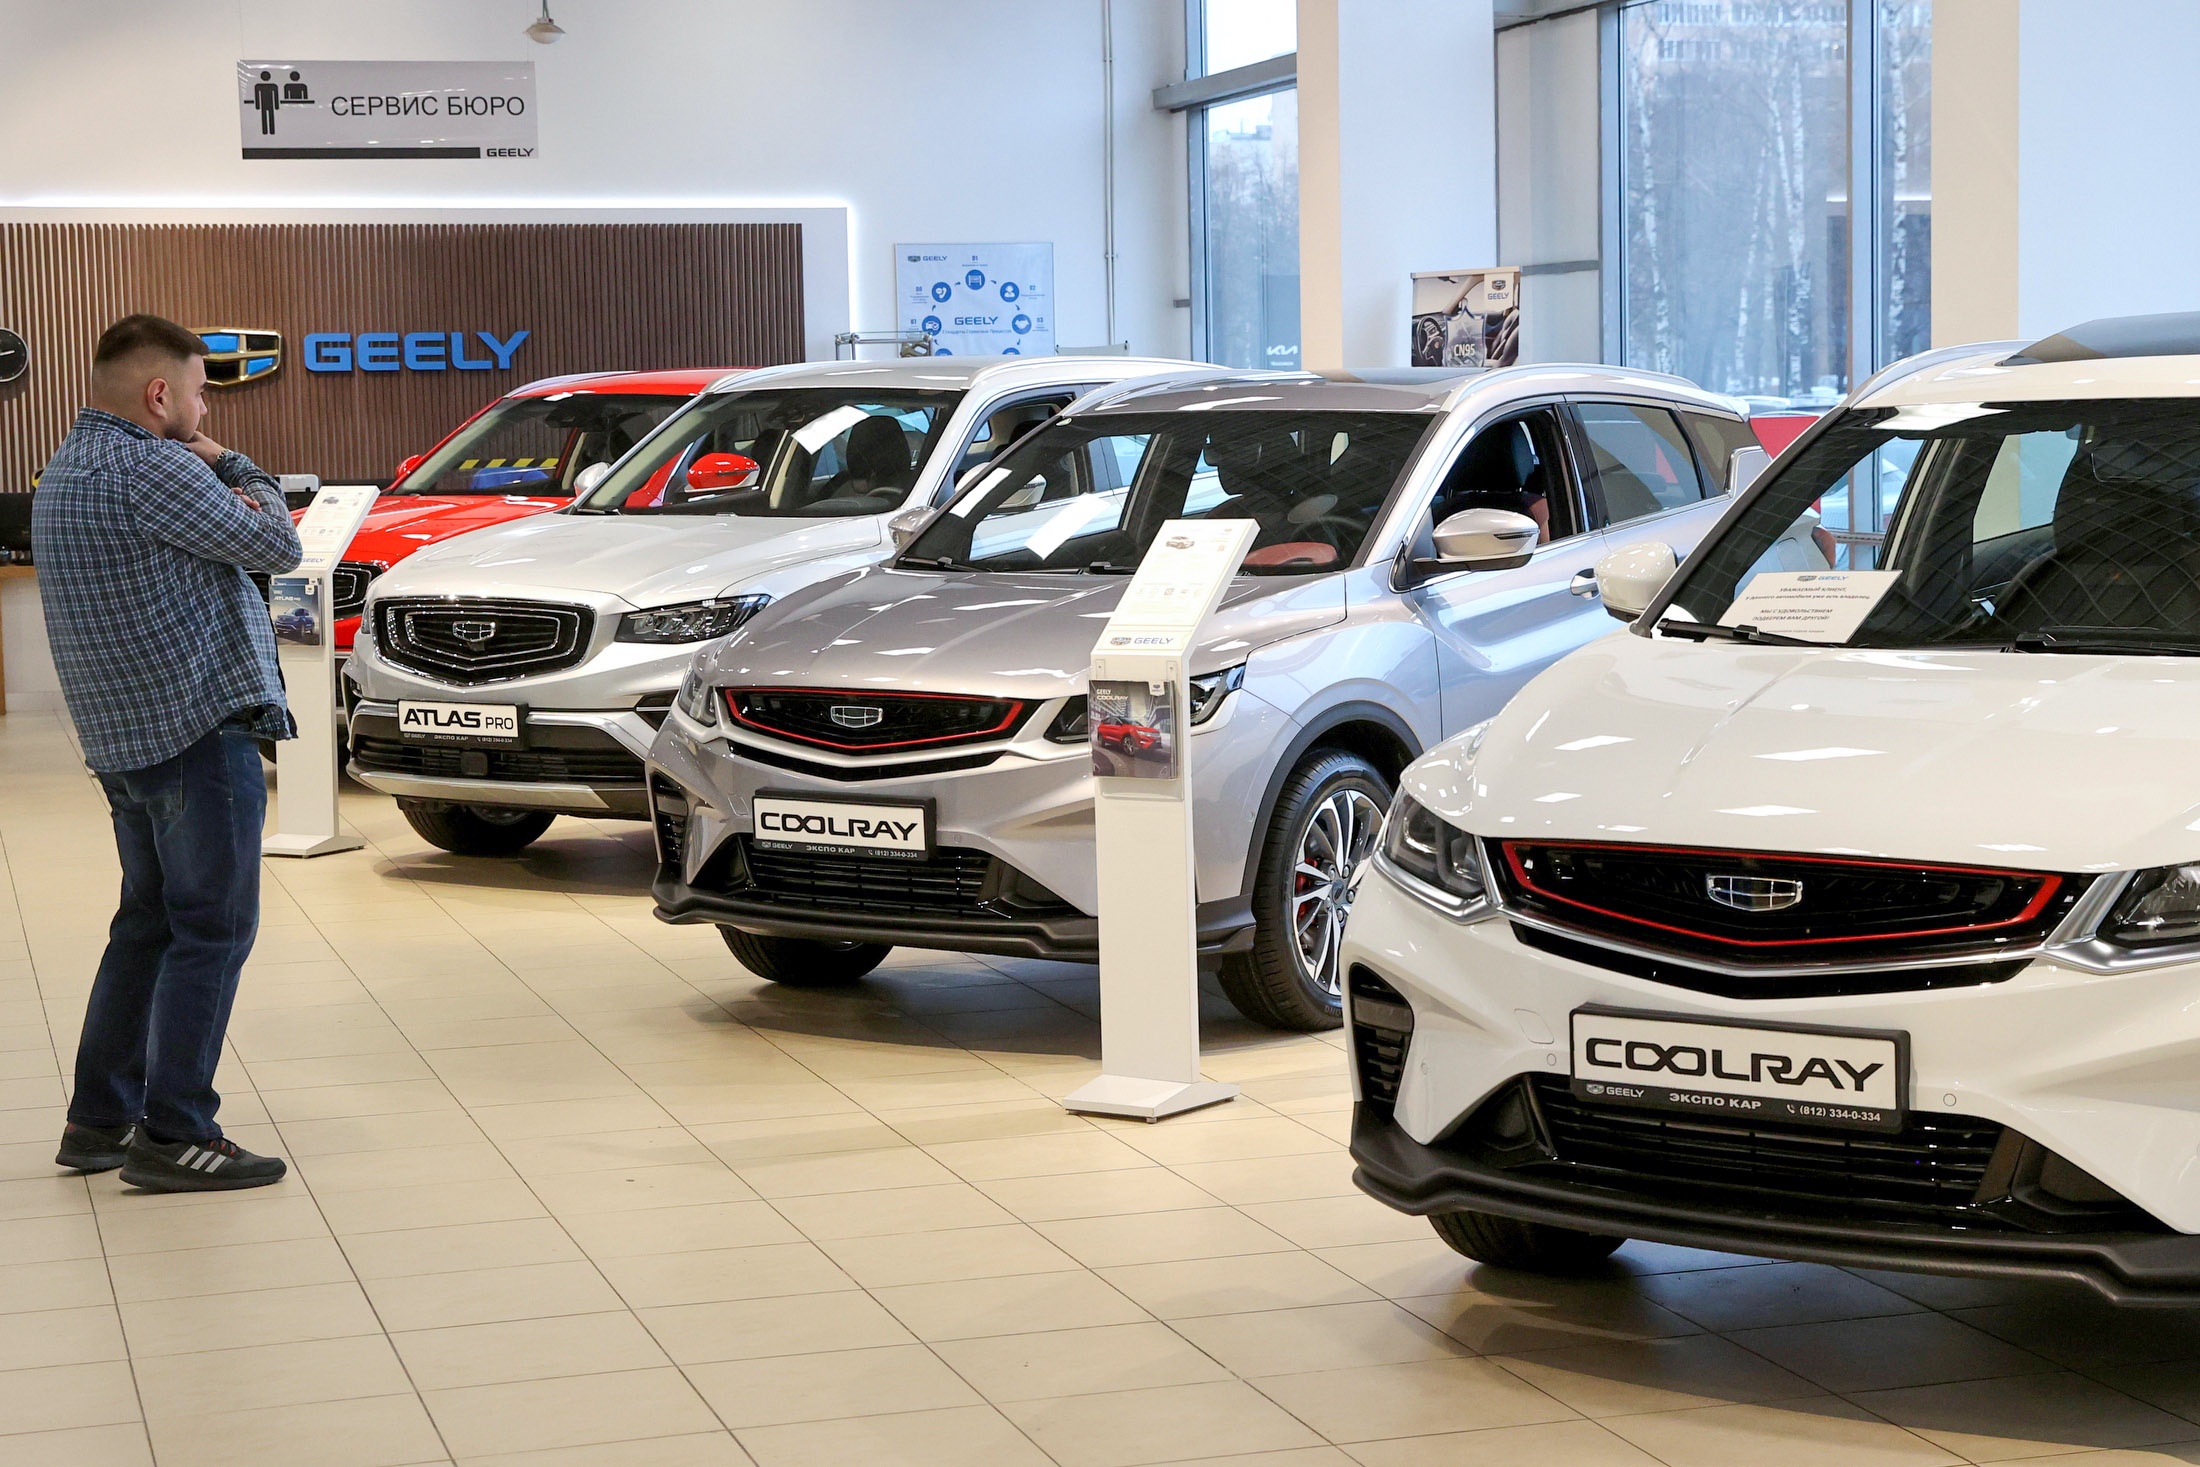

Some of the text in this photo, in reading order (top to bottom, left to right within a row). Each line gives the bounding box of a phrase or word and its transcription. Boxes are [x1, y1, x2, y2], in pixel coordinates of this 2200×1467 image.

[331, 96, 525, 116] СЕРВИС БЮРО
[486, 148, 534, 158] GEELY
[1487, 292, 1510, 300] GEELY
[954, 316, 999, 326] GEELY
[303, 331, 531, 372] GEELY
[1453, 343, 1475, 356] CN95
[404, 708, 514, 730] ATLAS PRO
[761, 811, 918, 842] COOLRAY
[806, 845, 836, 853] ЭКСПО
[874, 850, 890, 858] (812)
[1586, 1037, 1885, 1093] COOLRAY
[1606, 1086, 1645, 1098] GEELY
[1669, 1092, 1762, 1110] ЭКСПО КАР
[1799, 1105, 1881, 1122] (812) 334-0-334
